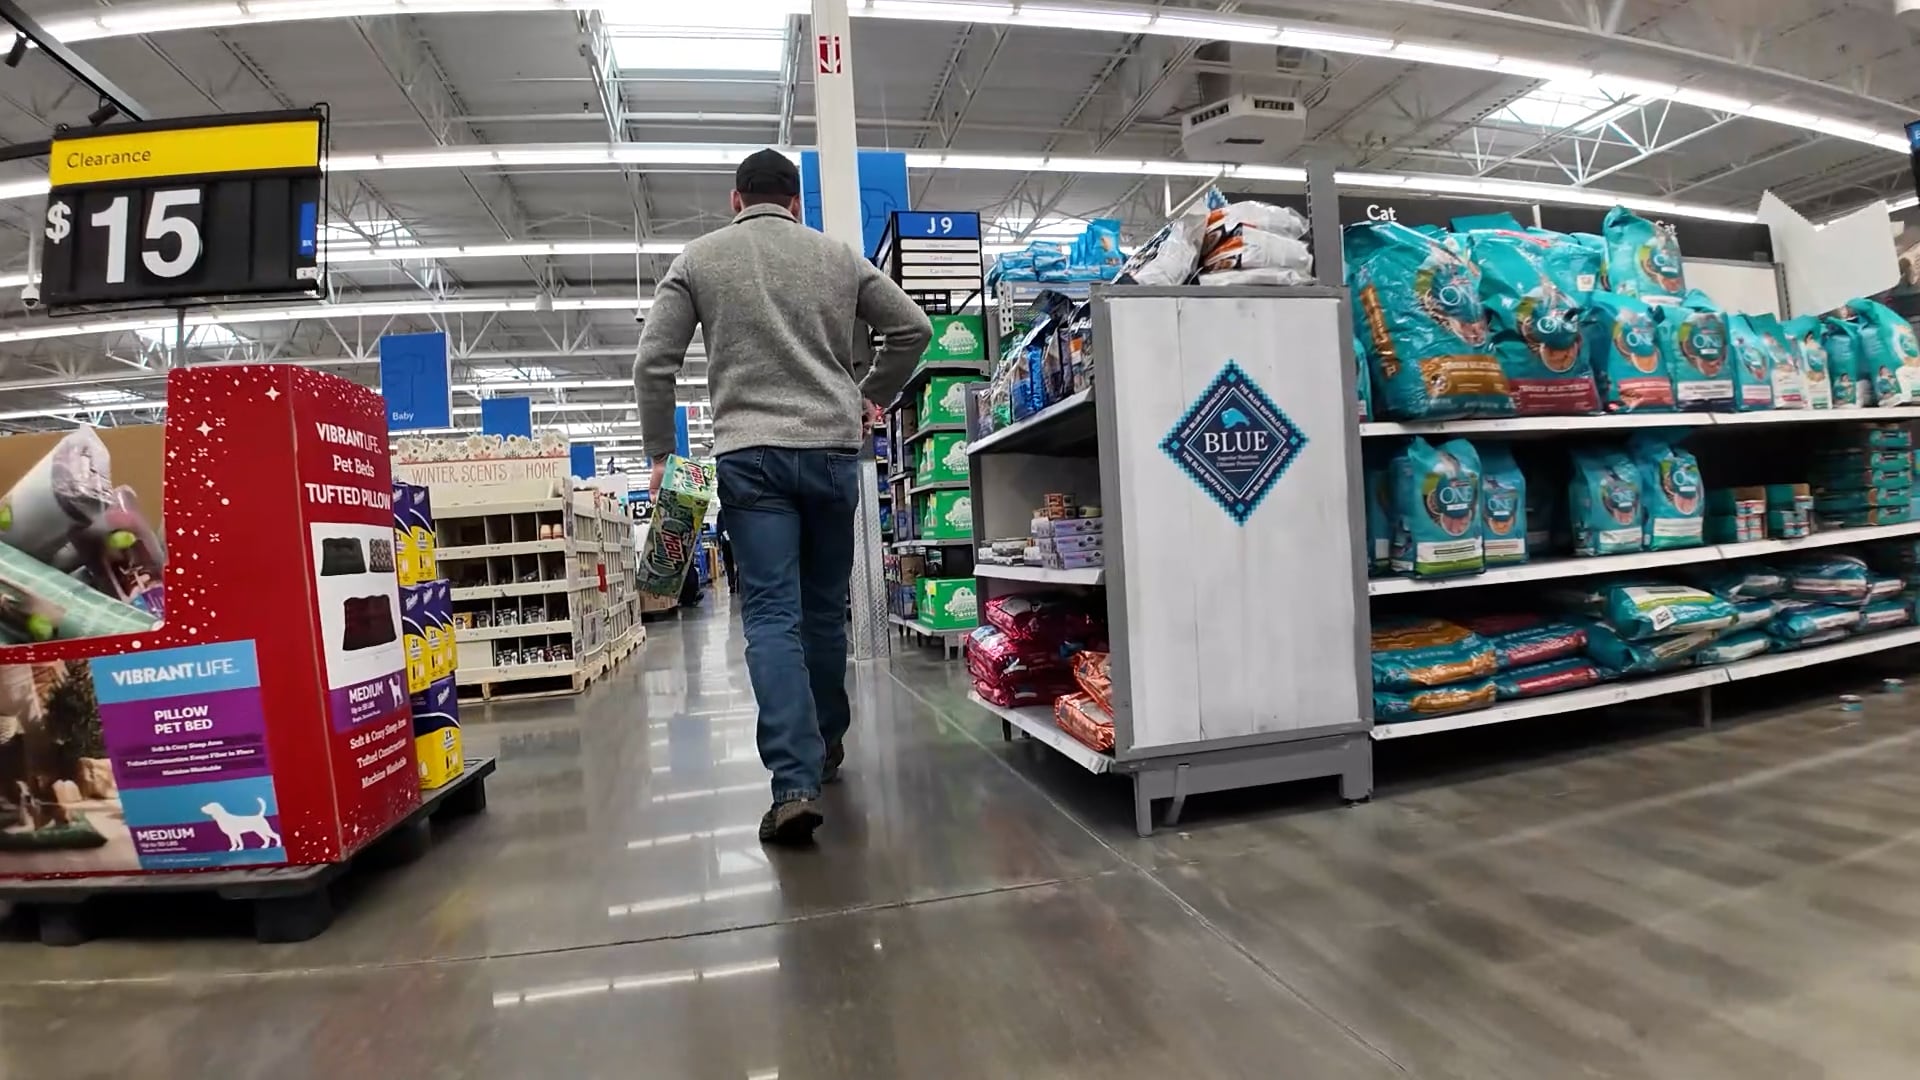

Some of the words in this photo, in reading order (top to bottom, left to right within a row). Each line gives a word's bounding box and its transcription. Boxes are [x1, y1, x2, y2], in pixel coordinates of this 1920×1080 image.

[66, 148, 152, 169] Clearance
[1366, 204, 1398, 221] Cat
[392, 412, 414, 422] Baby
[1180, 427, 1192, 439] THE
[1189, 414, 1202, 430] BLUE
[1200, 394, 1221, 418] BUFFALO
[1238, 384, 1250, 396] THE
[1248, 392, 1260, 408] BLUE
[1260, 404, 1282, 430] BUFFALO
[1204, 430, 1268, 454] BLUE
[332, 454, 354, 474] Pet
[354, 458, 375, 478] Beds
[412, 464, 458, 484] WINTER
[461, 464, 508, 482] SCENTS
[526, 461, 559, 480] HOME
[1182, 452, 1192, 464] THE
[1192, 460, 1205, 476] BLUE
[1204, 472, 1227, 496] BUFFALO
[1246, 490, 1256, 501] THE
[1254, 477, 1266, 492] BLUE
[1264, 456, 1284, 482] BUFFALO
[304, 483, 360, 505] TUFTED
[362, 488, 390, 510] PILLOW
[1440, 486, 1472, 504] ONE
[1488, 498, 1512, 510] ONE
[348, 681, 384, 704] MEDIUM
[154, 705, 209, 722] PILLOW
[154, 722, 182, 734] PET
[184, 718, 213, 732] BED
[350, 735, 364, 750] Soft
[365, 732, 371, 744] &
[371, 730, 384, 742] Cozy
[385, 723, 397, 735] Sleep
[356, 751, 378, 768] Tufted
[362, 769, 386, 788] Machine
[136, 828, 195, 840] MEDIUM
